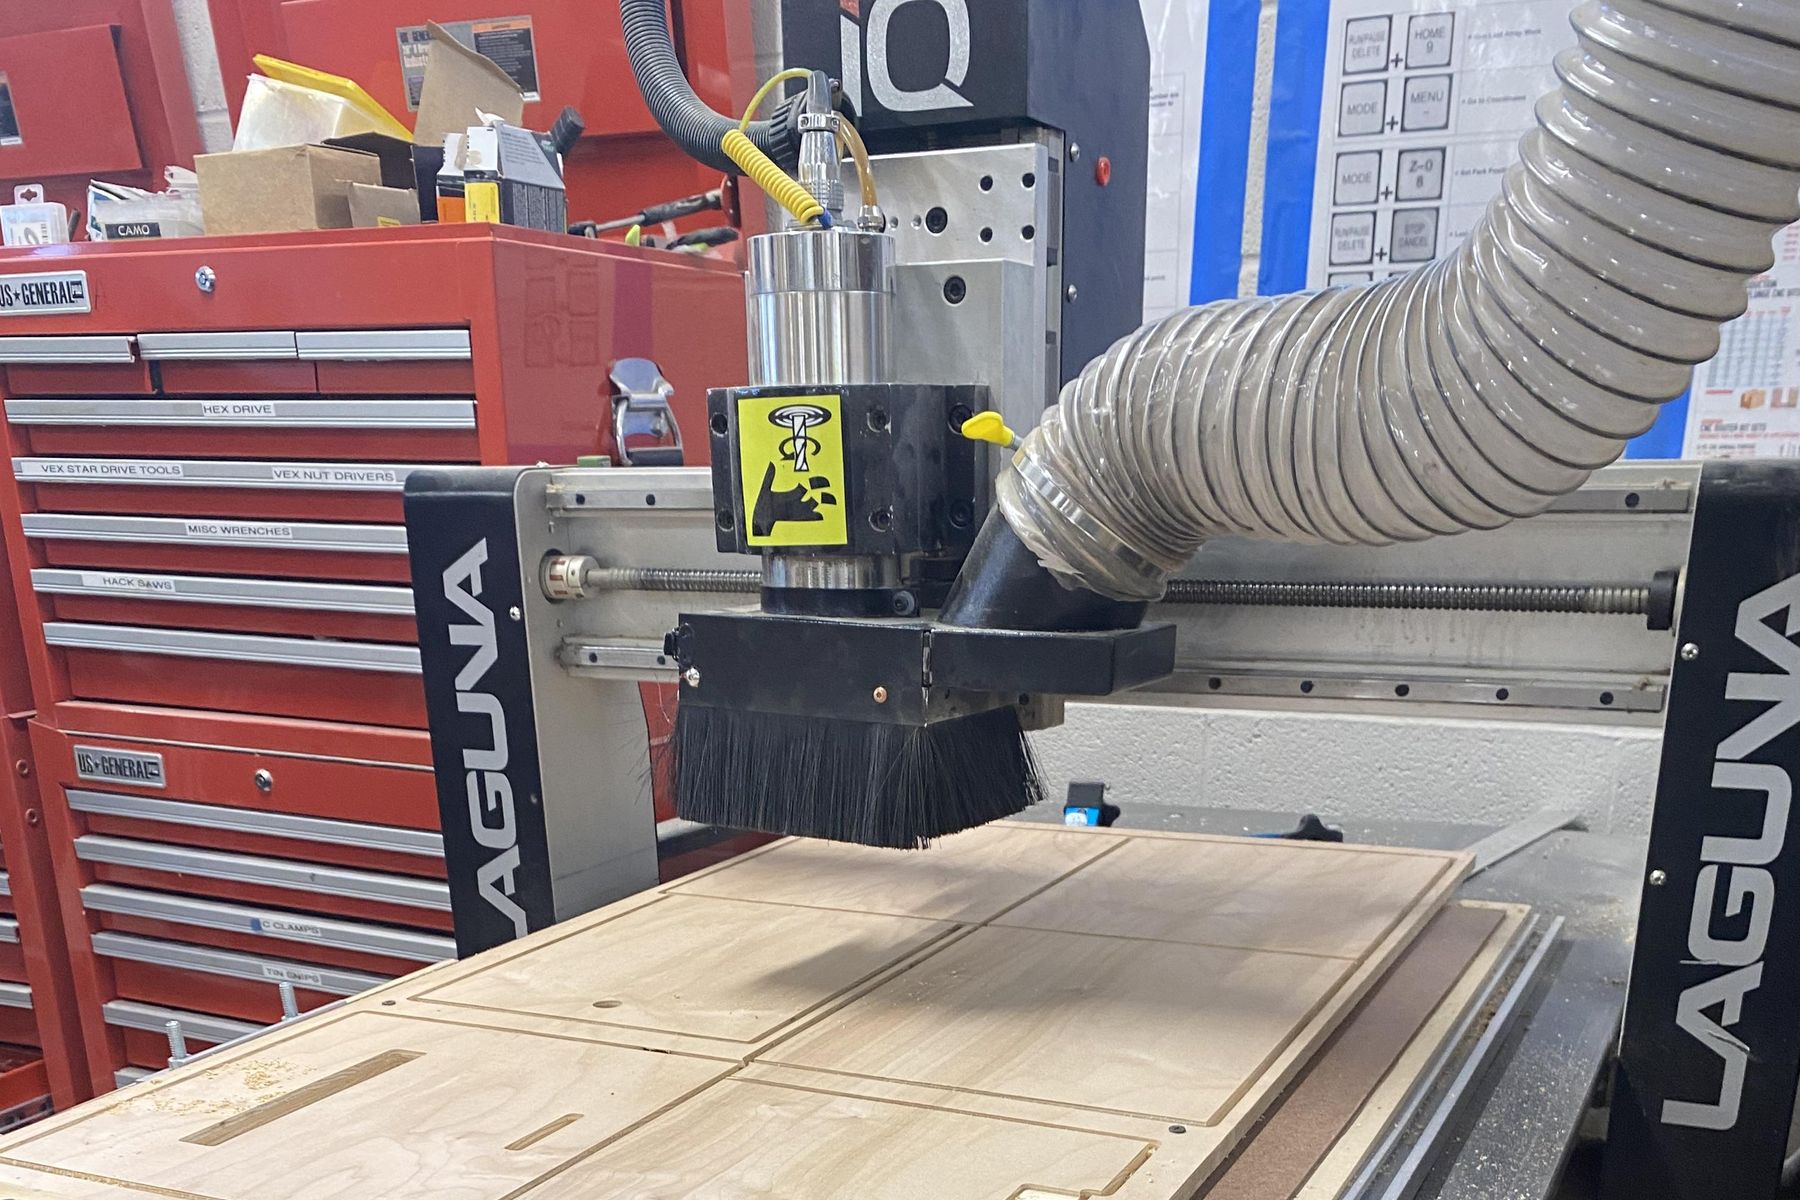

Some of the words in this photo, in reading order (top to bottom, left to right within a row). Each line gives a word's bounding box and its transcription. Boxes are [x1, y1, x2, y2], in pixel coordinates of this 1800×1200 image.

[1415, 27, 1446, 39] HOME
[1352, 46, 1381, 59] DELETE
[1426, 41, 1434, 54] 9
[1411, 91, 1444, 103] MENU
[1347, 101, 1378, 115] MODE
[1342, 172, 1372, 184] MODE
[1416, 175, 1424, 188] 8
[118, 225, 150, 237] CAMO
[1404, 222, 1426, 235] STOP
[1338, 239, 1366, 251] DELETE
[21, 279, 75, 305] GENERAL
[203, 404, 229, 414] HEX
[232, 404, 272, 414] DRIVE
[41, 464, 64, 473] VEX
[67, 465, 98, 474] STAR
[101, 465, 137, 475] DRIVE
[140, 465, 181, 475] TOOLS
[273, 469, 300, 479] VEX
[303, 471, 329, 480] NUT
[334, 471, 394, 482] DRIVERS
[188, 525, 218, 534] MISC
[220, 526, 291, 536] WRENCHES
[102, 577, 135, 587] HACK
[137, 579, 173, 590] SAWS
[443, 536, 529, 939] AGUNA
[78, 753, 94, 773] US
[101, 755, 151, 779] GENERAL
[1661, 571, 1800, 1131] LAGUNA
[262, 920, 270, 928] C
[272, 921, 319, 935] CLAMPS
[266, 967, 285, 978] TIN
